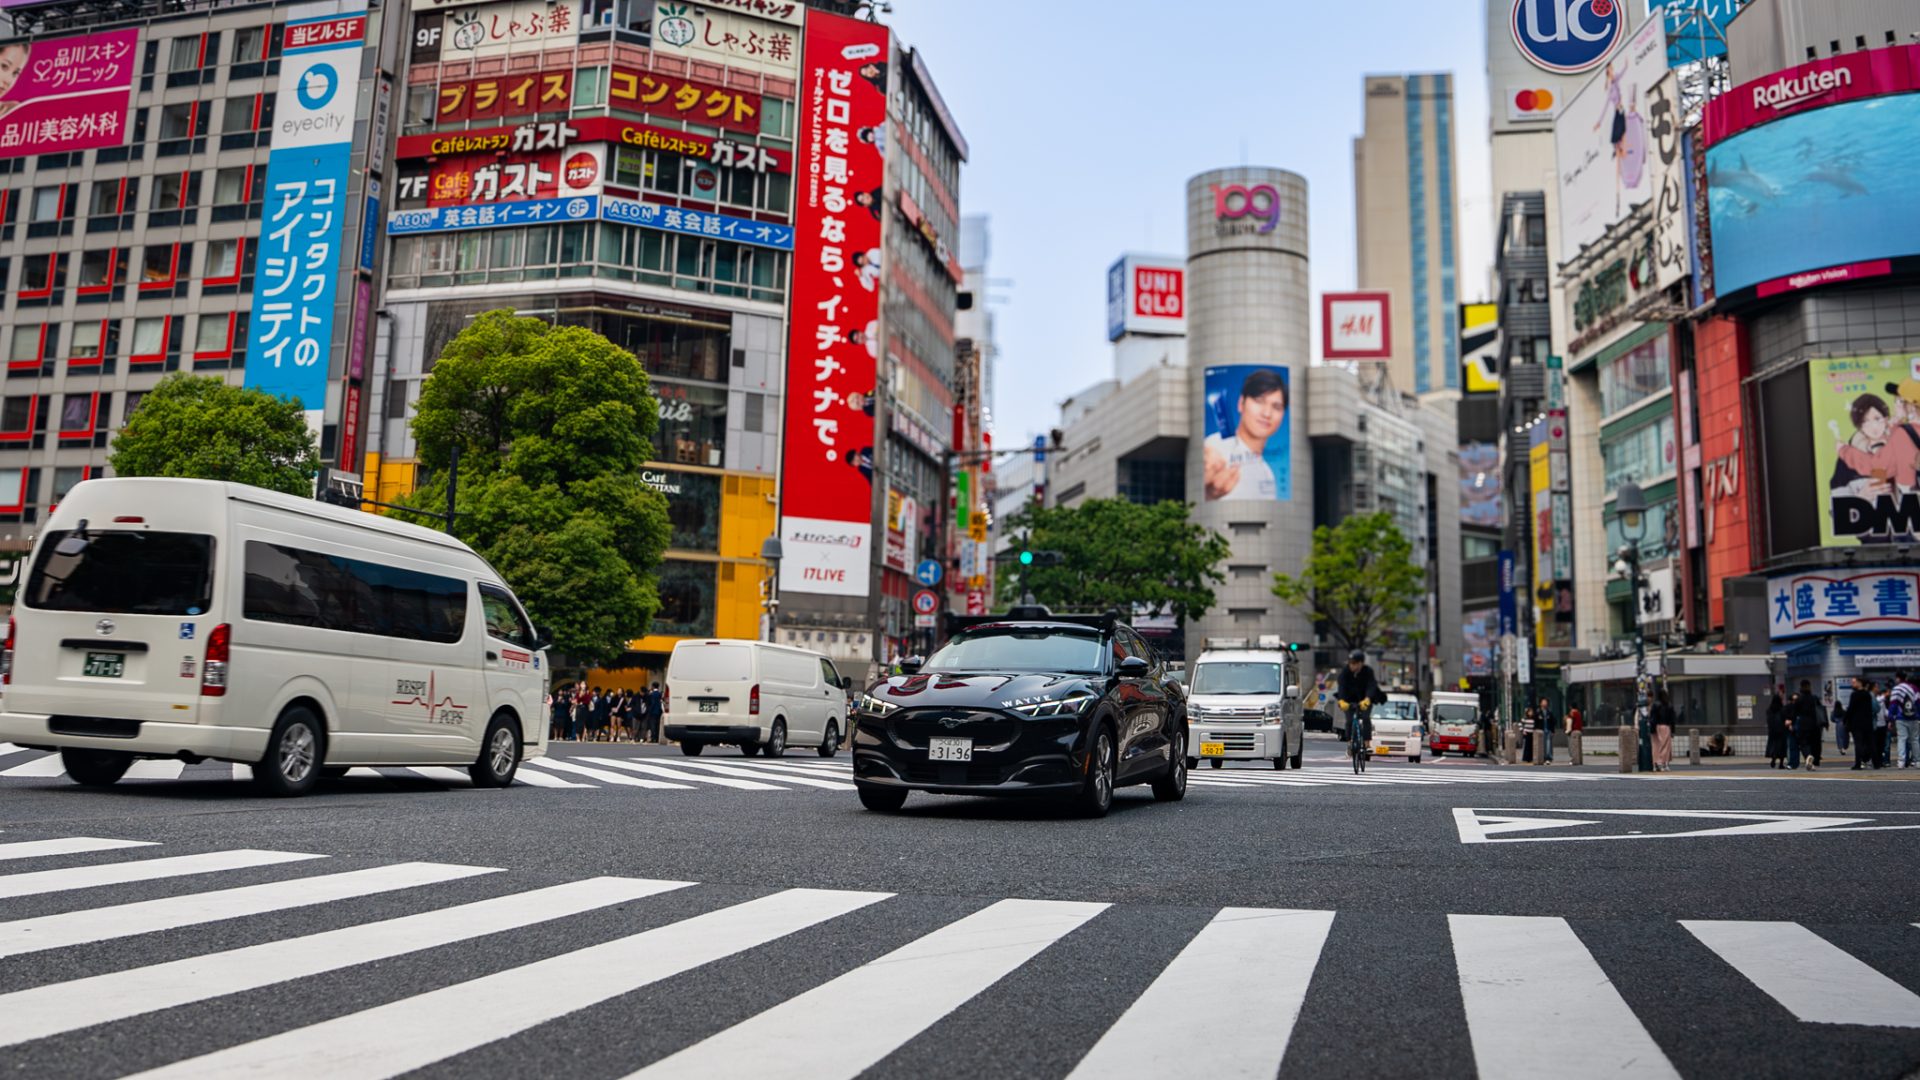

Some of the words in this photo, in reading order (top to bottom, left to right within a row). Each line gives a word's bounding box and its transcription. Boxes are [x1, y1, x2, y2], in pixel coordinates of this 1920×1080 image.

[291, 20, 358, 45] 当ビル5F
[489, 4, 571, 40] しゃぶ葉
[416, 27, 442, 47] 9F
[704, 18, 793, 61] しゃぶ葉
[53, 41, 131, 67] 品川スキン
[51, 63, 120, 88] クリニック
[1753, 66, 1852, 110] Rakuten
[440, 73, 570, 115] プライス
[611, 71, 757, 123] コンタクト
[1, 111, 119, 148] 品川美容外科
[282, 113, 345, 134] eyecity
[512, 121, 579, 152] ガスト
[711, 139, 778, 173] ガスト
[399, 176, 429, 199] 7F
[434, 172, 470, 189] Café
[471, 162, 553, 201] ガスト
[394, 213, 432, 229] AEON
[443, 203, 561, 227] 英会話イーオン
[568, 200, 588, 217] 6F
[609, 202, 652, 220] AEON
[664, 209, 790, 243] 英会話イーオン
[1139, 270, 1177, 293] UNI
[1138, 292, 1180, 315] QLO
[1775, 578, 1912, 624] 大盛堂書
[397, 679, 426, 696] RESPI
[1001, 695, 1052, 707] WAYVE
[937, 747, 970, 760] 31-96
